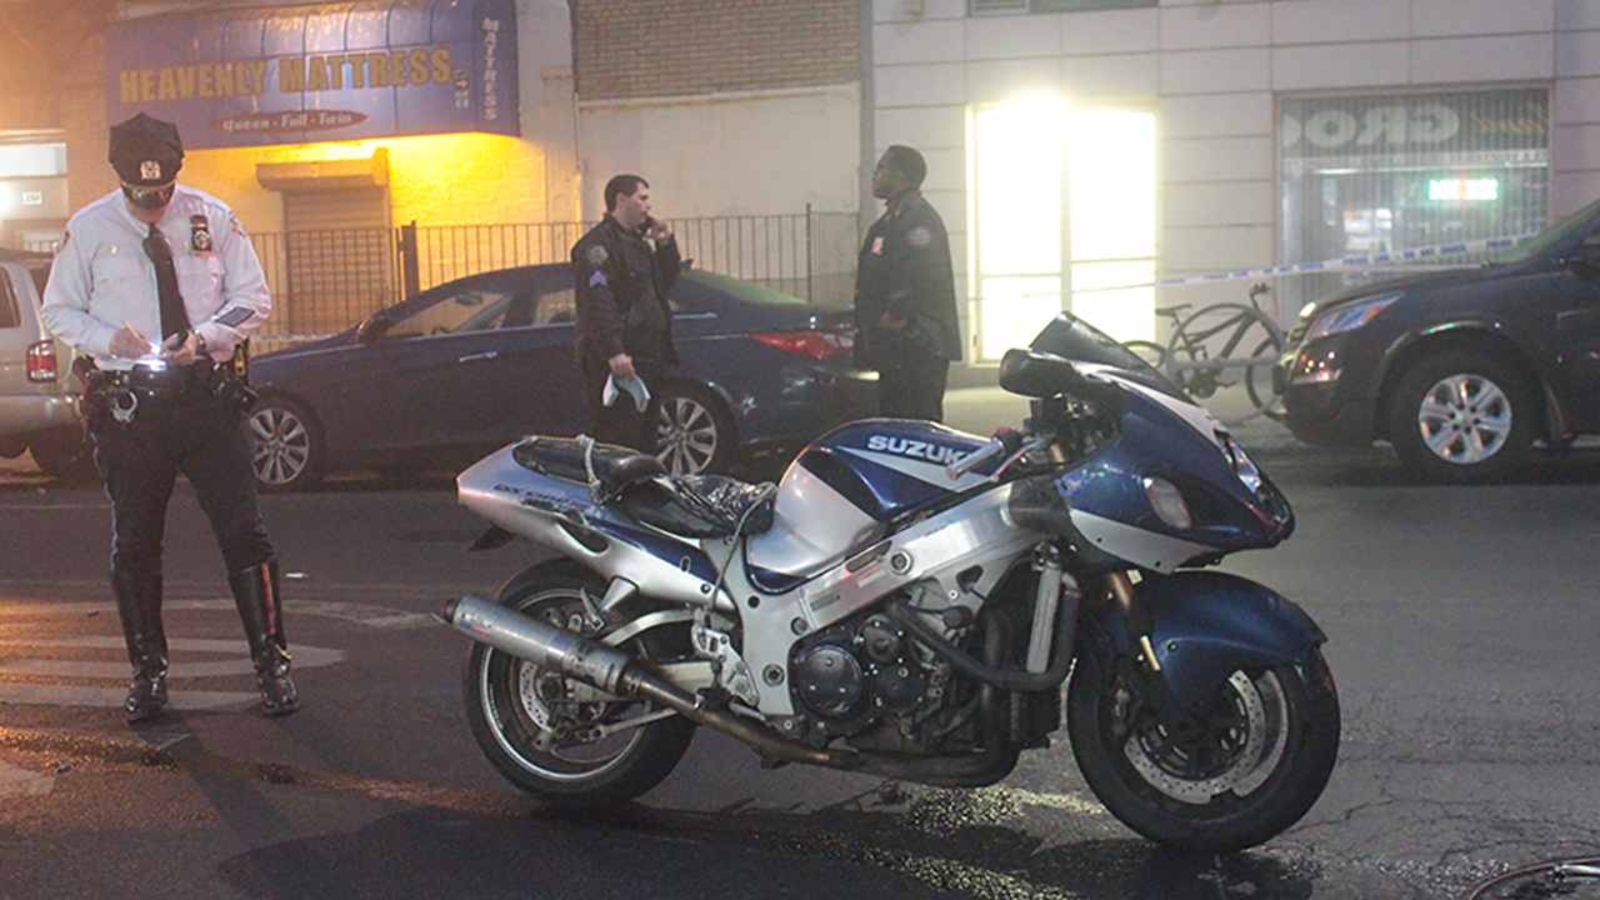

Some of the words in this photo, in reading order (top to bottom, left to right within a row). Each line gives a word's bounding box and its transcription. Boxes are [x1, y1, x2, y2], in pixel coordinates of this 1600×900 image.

[120, 60, 267, 104] HEAVENLY
[279, 48, 451, 93] MATTRESS
[482, 17, 499, 120] MATTRESS
[867, 434, 967, 465] SUZUK
